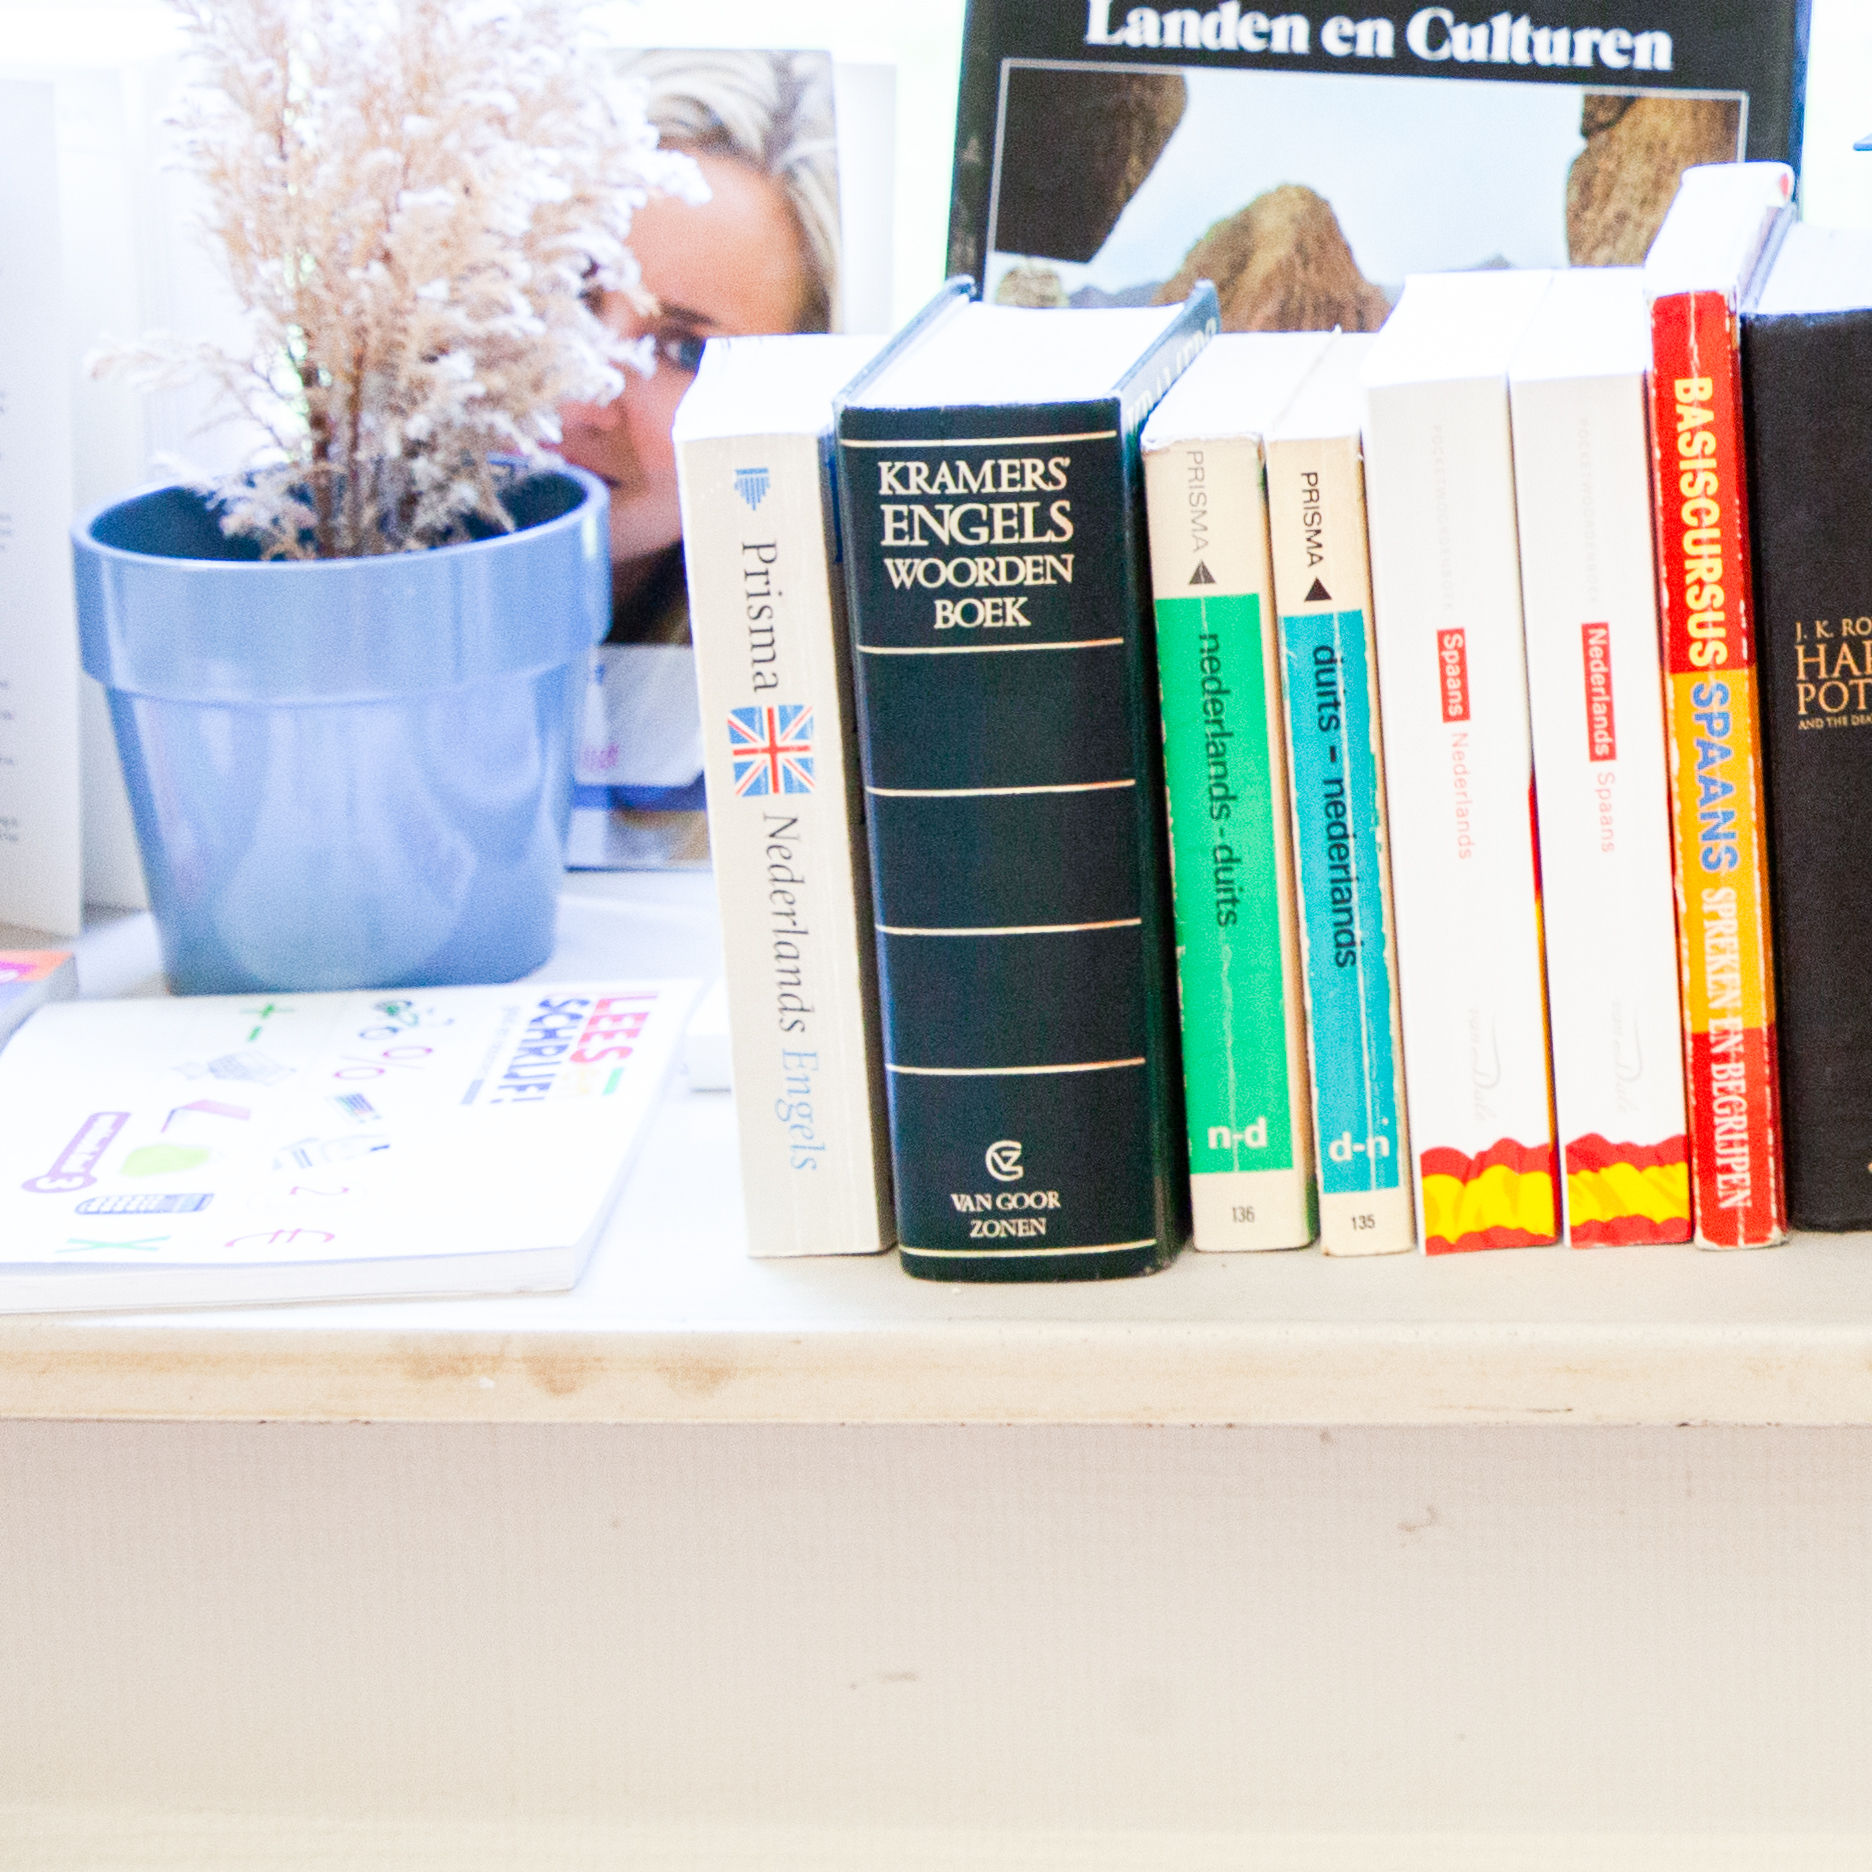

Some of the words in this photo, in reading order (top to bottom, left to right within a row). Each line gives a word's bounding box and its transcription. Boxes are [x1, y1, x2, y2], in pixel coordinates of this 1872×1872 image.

[1321, 14, 1395, 59] en
[1407, 7, 1673, 72] Culturen
[880, 502, 1075, 548] ENGELS
[1187, 450, 1208, 553] PRISMA
[1301, 472, 1324, 568] PRISMA
[1674, 377, 1729, 668] BASISCURSUS
[884, 553, 1074, 589] WOORDEN
[933, 596, 1030, 630] BOEK
[741, 538, 779, 695] Prisma
[1796, 622, 1808, 643] J.
[1815, 620, 1834, 638] K.
[1313, 645, 1346, 732] duits
[1441, 633, 1464, 717] Spaans
[1588, 628, 1613, 757] Nederlands
[1199, 633, 1237, 821] nederlands
[1799, 717, 1824, 730] AND
[1827, 715, 1848, 728] THE
[1452, 732, 1475, 859] Nederlands
[1595, 772, 1616, 853] Spaans
[1692, 682, 1739, 874] SPAANS
[1213, 844, 1243, 928] duits
[1323, 779, 1364, 968] nederlands
[762, 812, 806, 1033] Nederlands
[1701, 887, 1742, 1010] SPREKEN
[569, 994, 658, 1063] LEES
[1708, 1017, 1745, 1055] EN
[780, 1047, 820, 1173] Engels
[1209, 1119, 1266, 1150] n-d
[1328, 1134, 1389, 1163] d-n
[1710, 1061, 1753, 1209] BEGRIJPEN
[950, 1193, 993, 1212] VAN
[996, 1190, 1061, 1210] GOOR
[969, 1217, 1047, 1238] ZONEN
[1230, 1205, 1255, 1224] 136
[1351, 1215, 1376, 1231] 135
